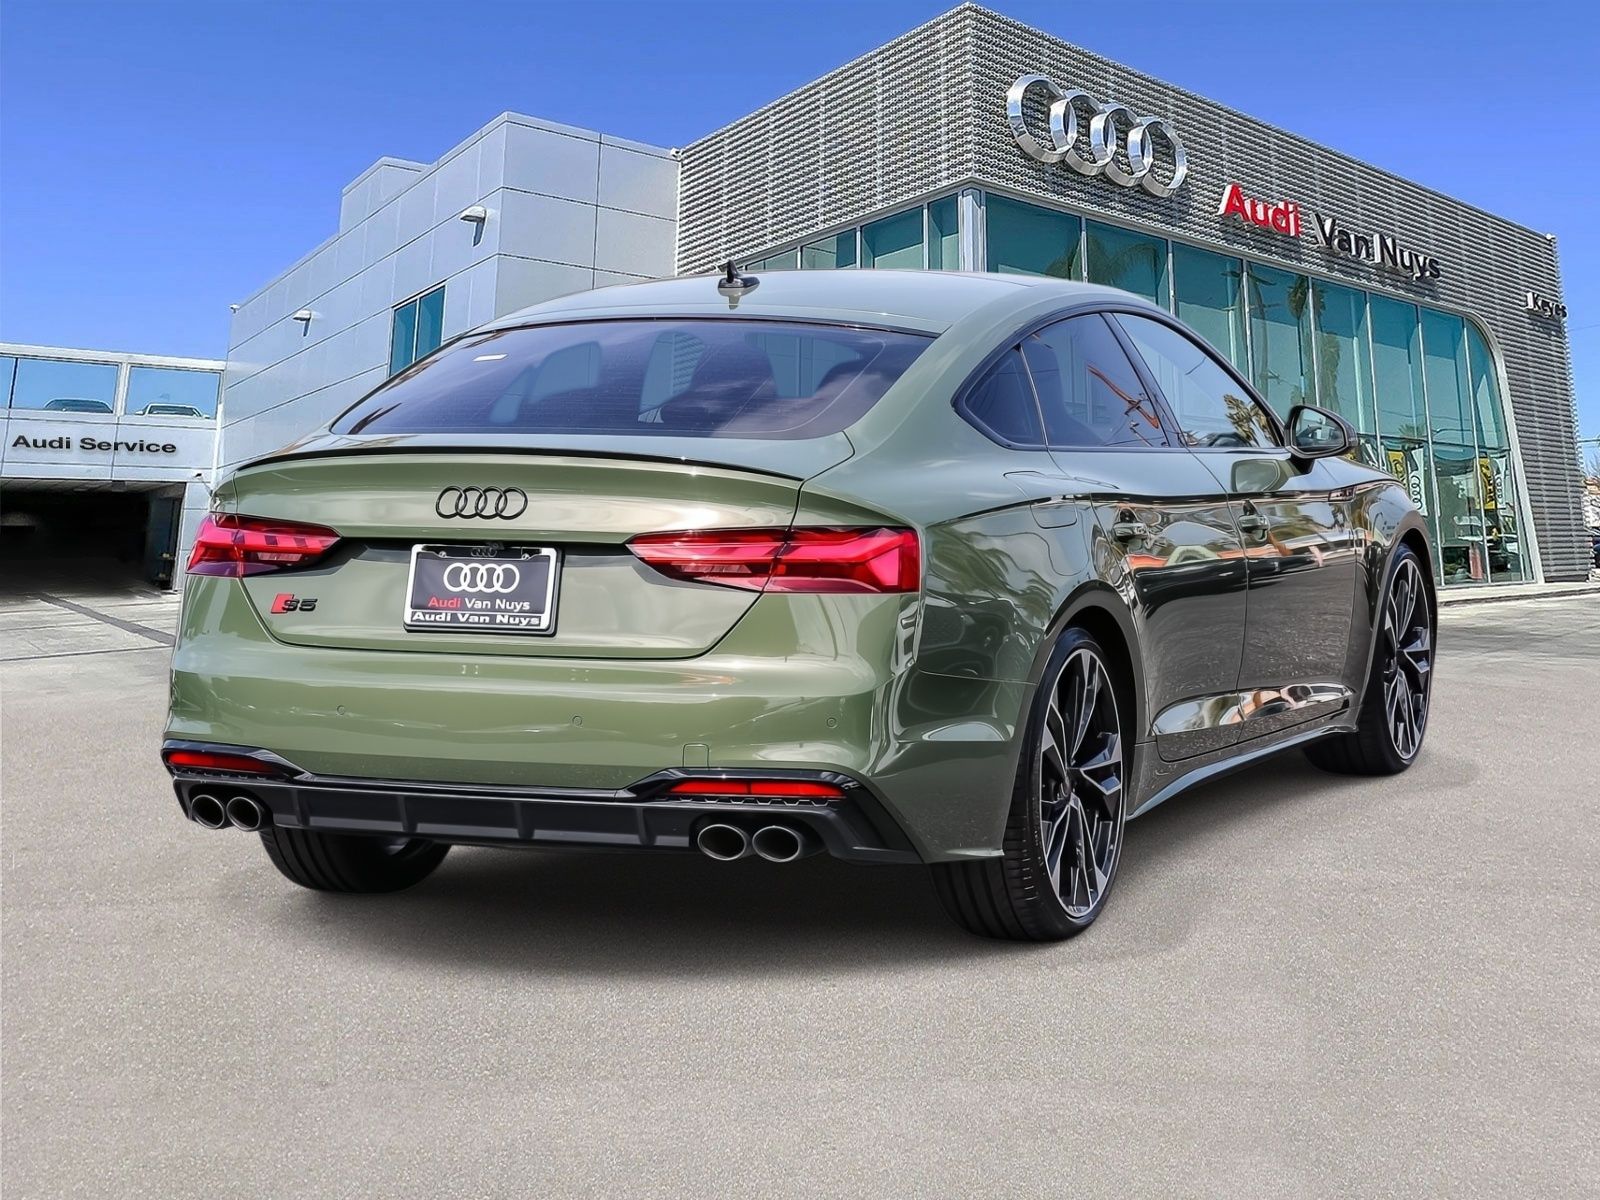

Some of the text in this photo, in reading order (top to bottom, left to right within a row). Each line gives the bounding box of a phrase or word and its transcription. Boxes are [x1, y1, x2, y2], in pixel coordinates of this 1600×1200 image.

[1218, 182, 1441, 281] Audi Van Nuys
[1526, 291, 1568, 318] Keyes
[12, 435, 177, 454] Audi Service
[280, 598, 318, 612] S5
[427, 596, 530, 611] Audi Van Nuys
[412, 611, 541, 626] Audi Van Nuys
